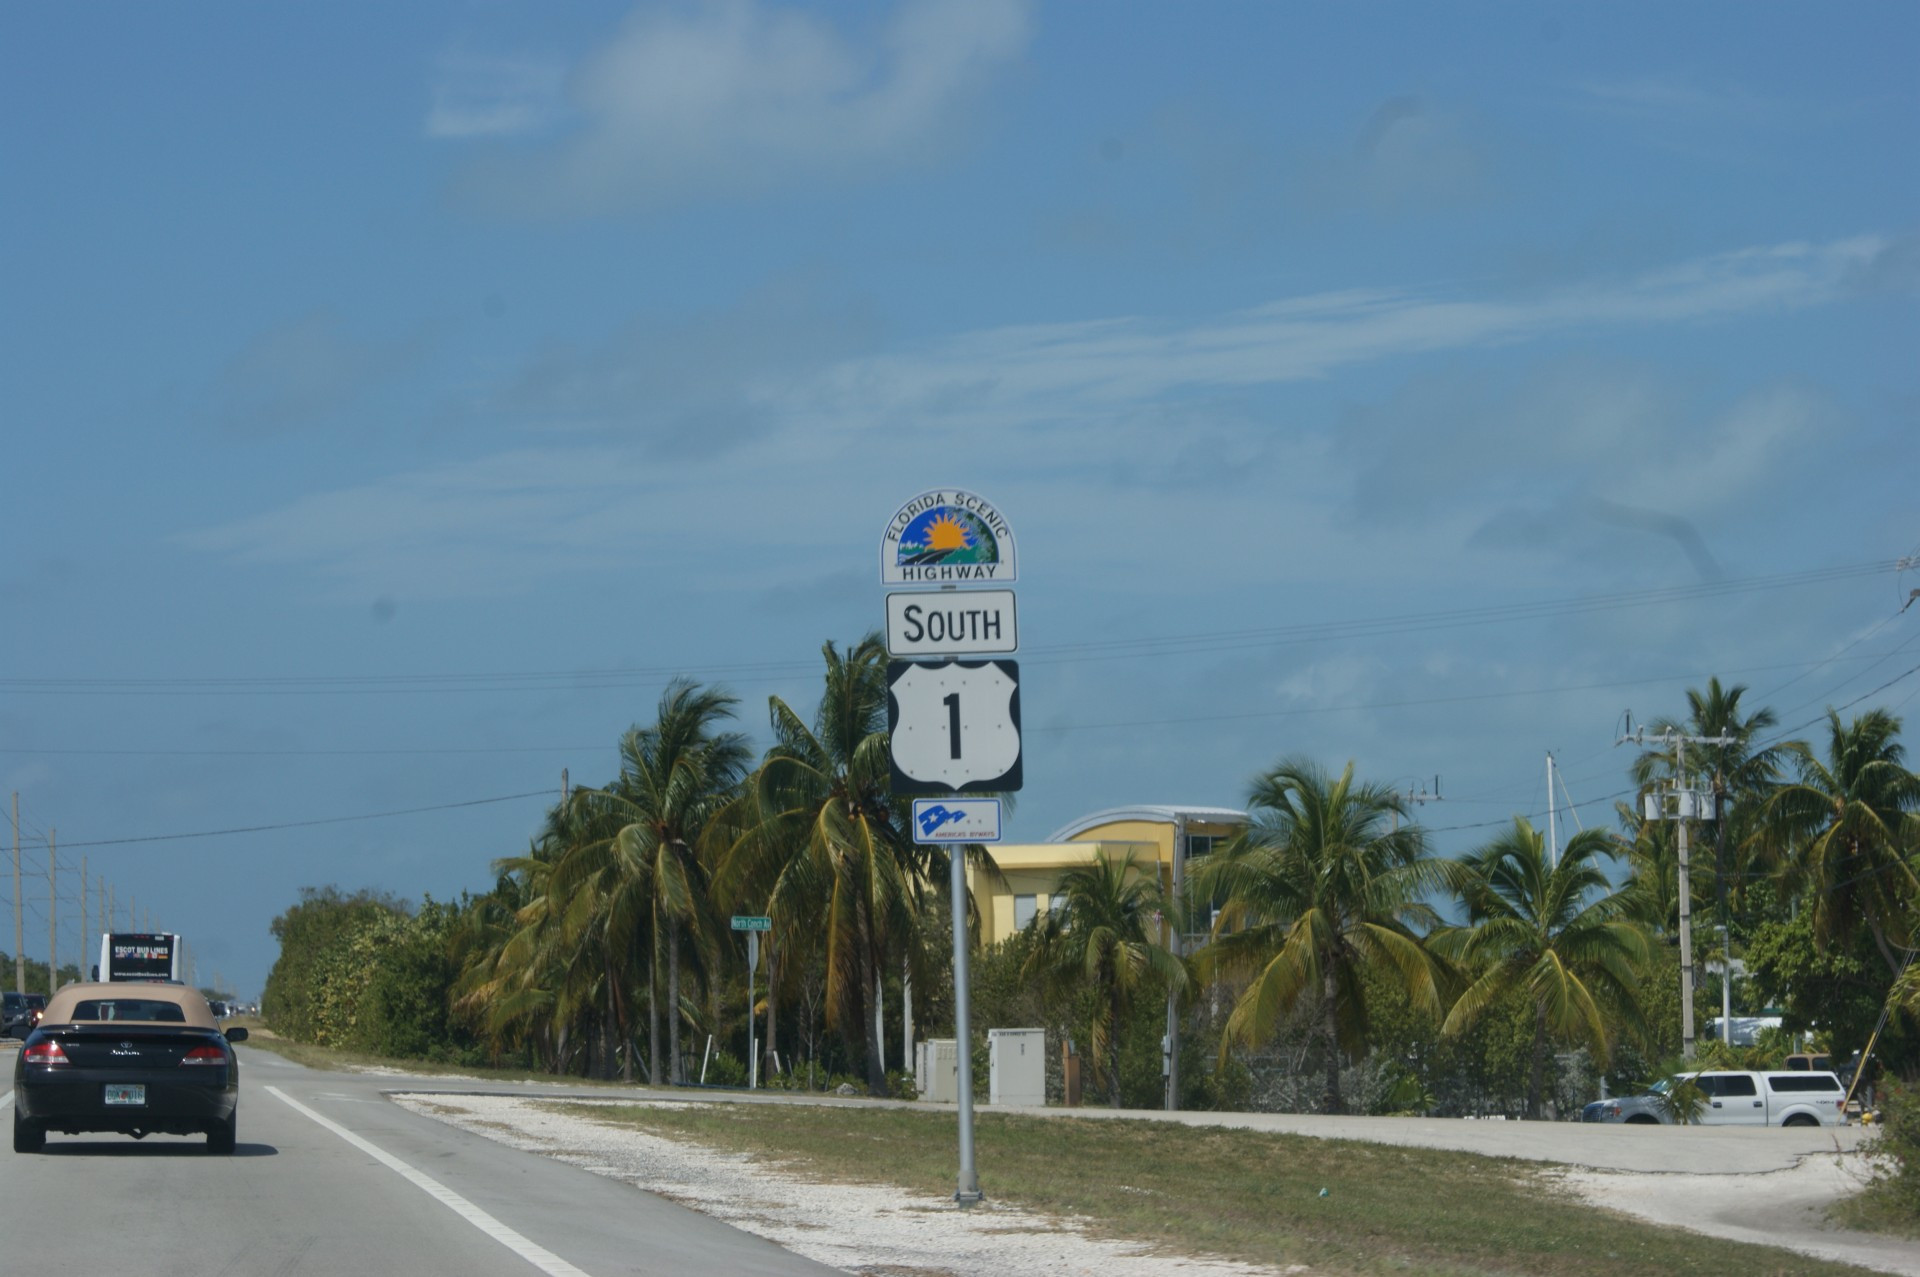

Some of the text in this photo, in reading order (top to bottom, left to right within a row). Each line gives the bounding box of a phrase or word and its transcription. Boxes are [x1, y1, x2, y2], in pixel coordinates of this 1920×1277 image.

[887, 493, 1008, 542] FLORIDA SCENIC
[902, 565, 997, 581] HIGHWAY
[903, 604, 1001, 643] SOUTH
[943, 692, 961, 760] 1
[732, 918, 747, 928] North
[747, 919, 762, 929] Conch
[115, 945, 135, 953] ESCOT
[150, 946, 168, 954] LINES
